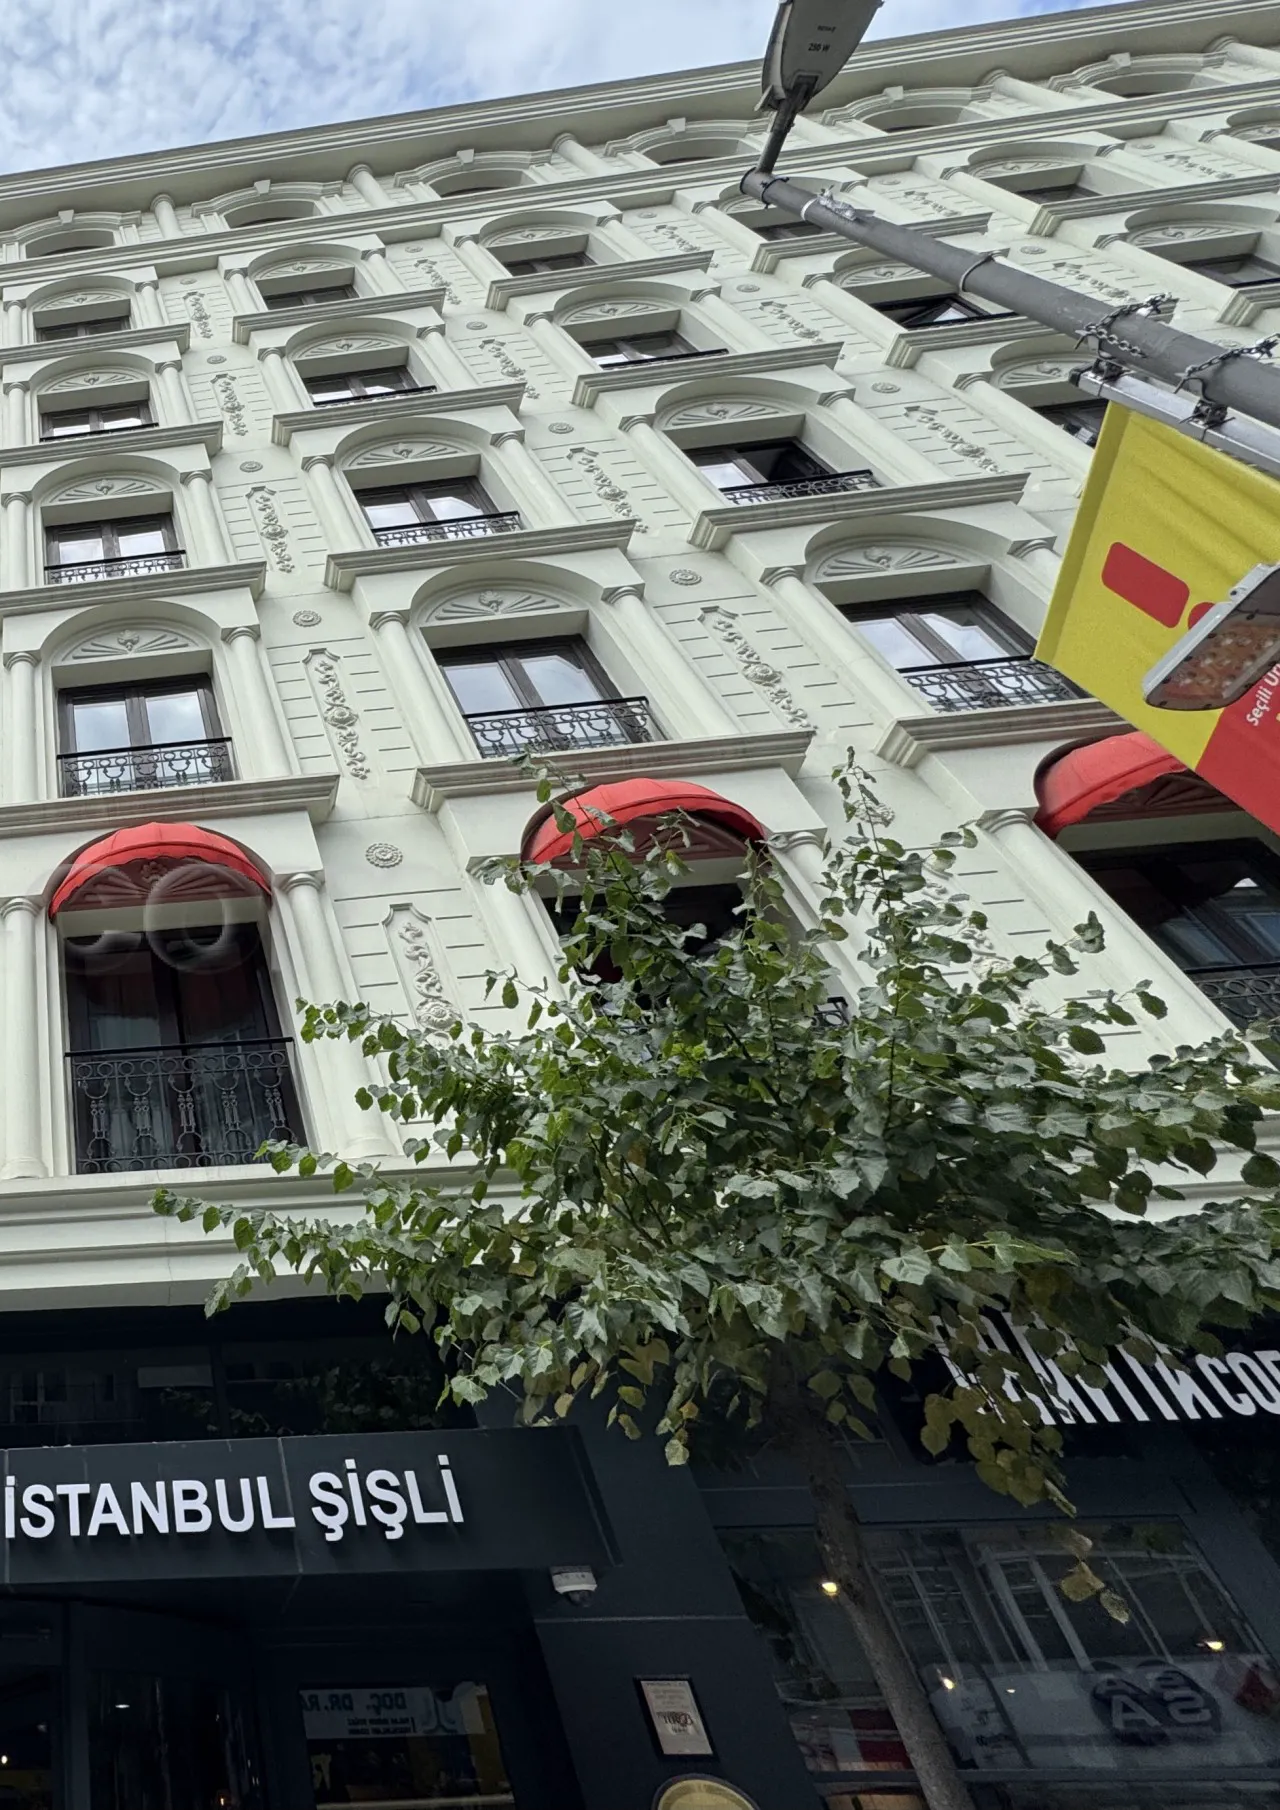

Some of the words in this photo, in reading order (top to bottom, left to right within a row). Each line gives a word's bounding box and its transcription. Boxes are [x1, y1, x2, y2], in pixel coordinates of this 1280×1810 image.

[1246, 686, 1273, 727] Seçili
[4, 1475, 296, 1539] İSTANBUL
[309, 1454, 464, 1542] ŞİŞLİ
